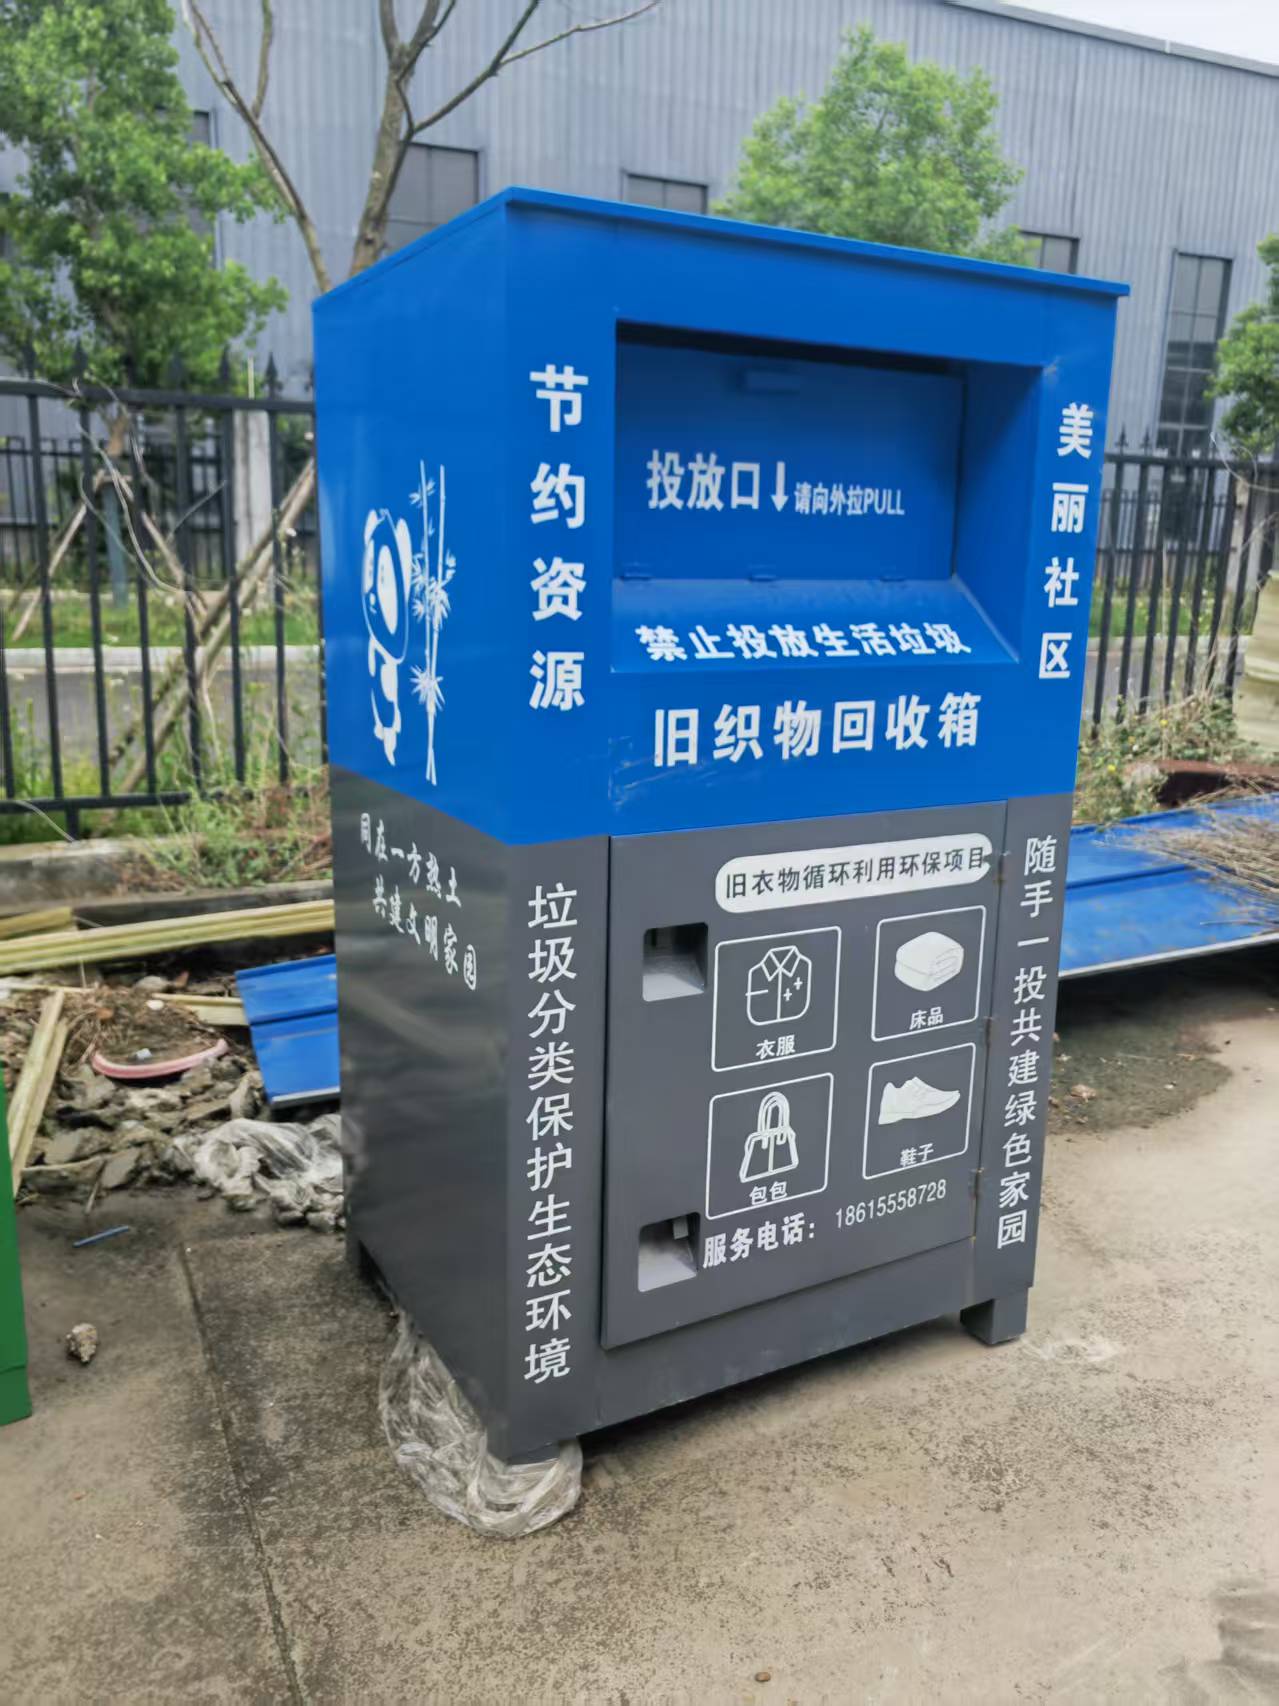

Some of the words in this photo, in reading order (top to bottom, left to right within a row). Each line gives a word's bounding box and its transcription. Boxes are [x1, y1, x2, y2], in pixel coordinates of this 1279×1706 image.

[646, 449, 760, 512] 投放口
[529, 364, 588, 711] 节约资源
[1038, 402, 1094, 680] 美丽社区
[635, 622, 972, 662] 禁止投放生活垃圾
[653, 691, 982, 768] 旧织物回收箱
[725, 846, 985, 899] 旧衣物循环利用环保项目
[908, 1005, 945, 1031] 床品
[996, 836, 1058, 1250] 随手一投共建绿色家园
[755, 1034, 797, 1059] 衣服
[523, 881, 579, 1385] 垃圾分类保护生态环境
[899, 1141, 935, 1168] 鞋子
[747, 1179, 789, 1207] 包包
[835, 1178, 947, 1229] 18615558728
